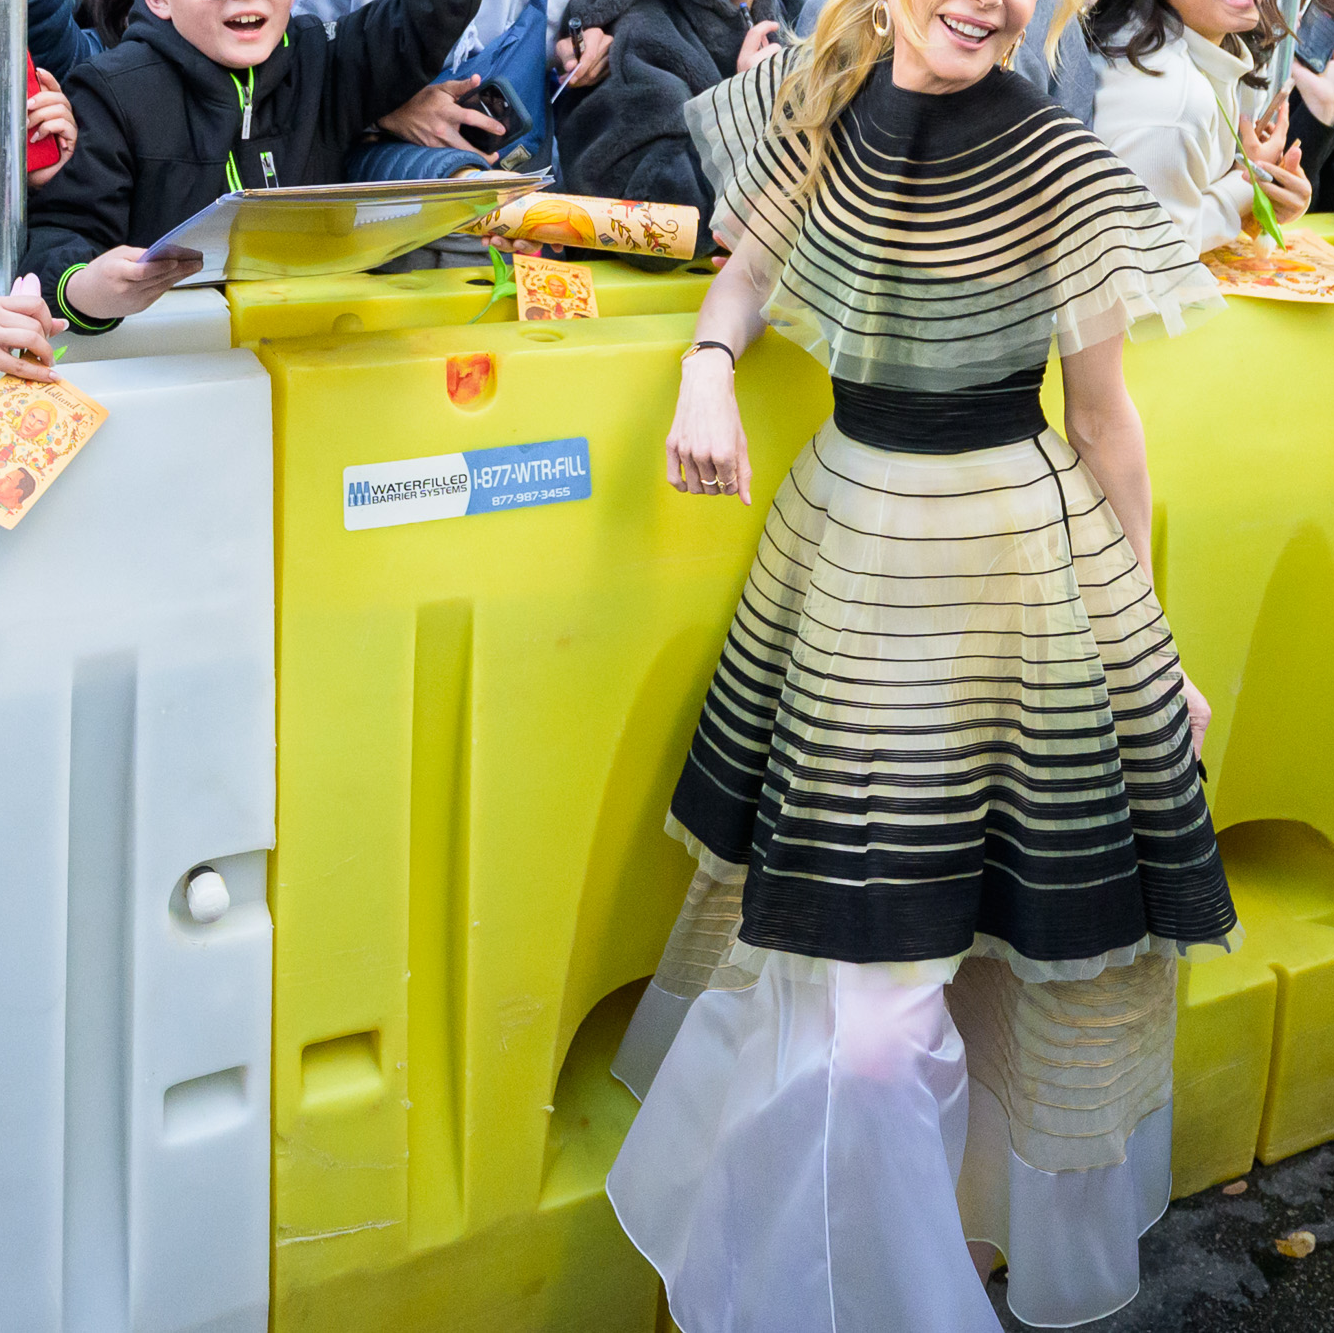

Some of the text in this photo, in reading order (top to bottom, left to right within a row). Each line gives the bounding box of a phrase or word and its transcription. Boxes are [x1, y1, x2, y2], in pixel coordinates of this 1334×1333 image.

[371, 473, 468, 495] WATERFILLED
[371, 485, 468, 505] BARRIER SYSTEMS
[491, 486, 571, 506] 877-987-3455
